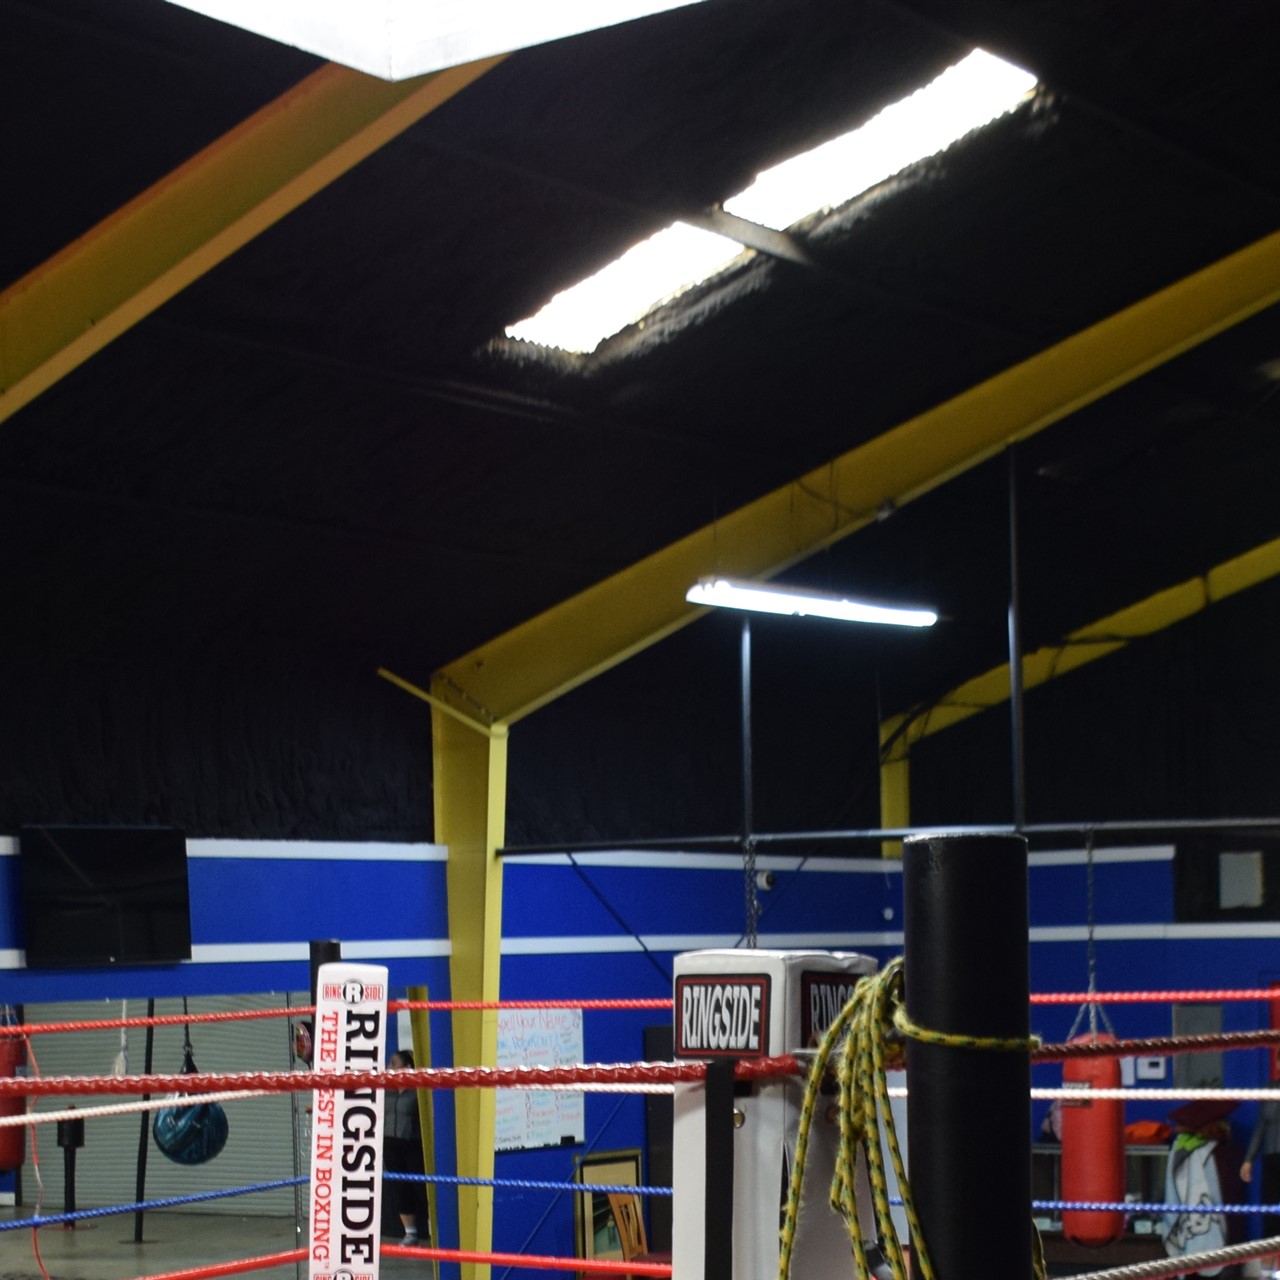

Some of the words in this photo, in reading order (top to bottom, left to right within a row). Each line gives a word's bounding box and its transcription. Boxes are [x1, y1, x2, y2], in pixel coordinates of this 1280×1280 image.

[320, 1011, 339, 1062] THE
[682, 984, 761, 1050] RINGSIDE
[316, 1068, 335, 1128] EST
[316, 1134, 334, 1162] IN
